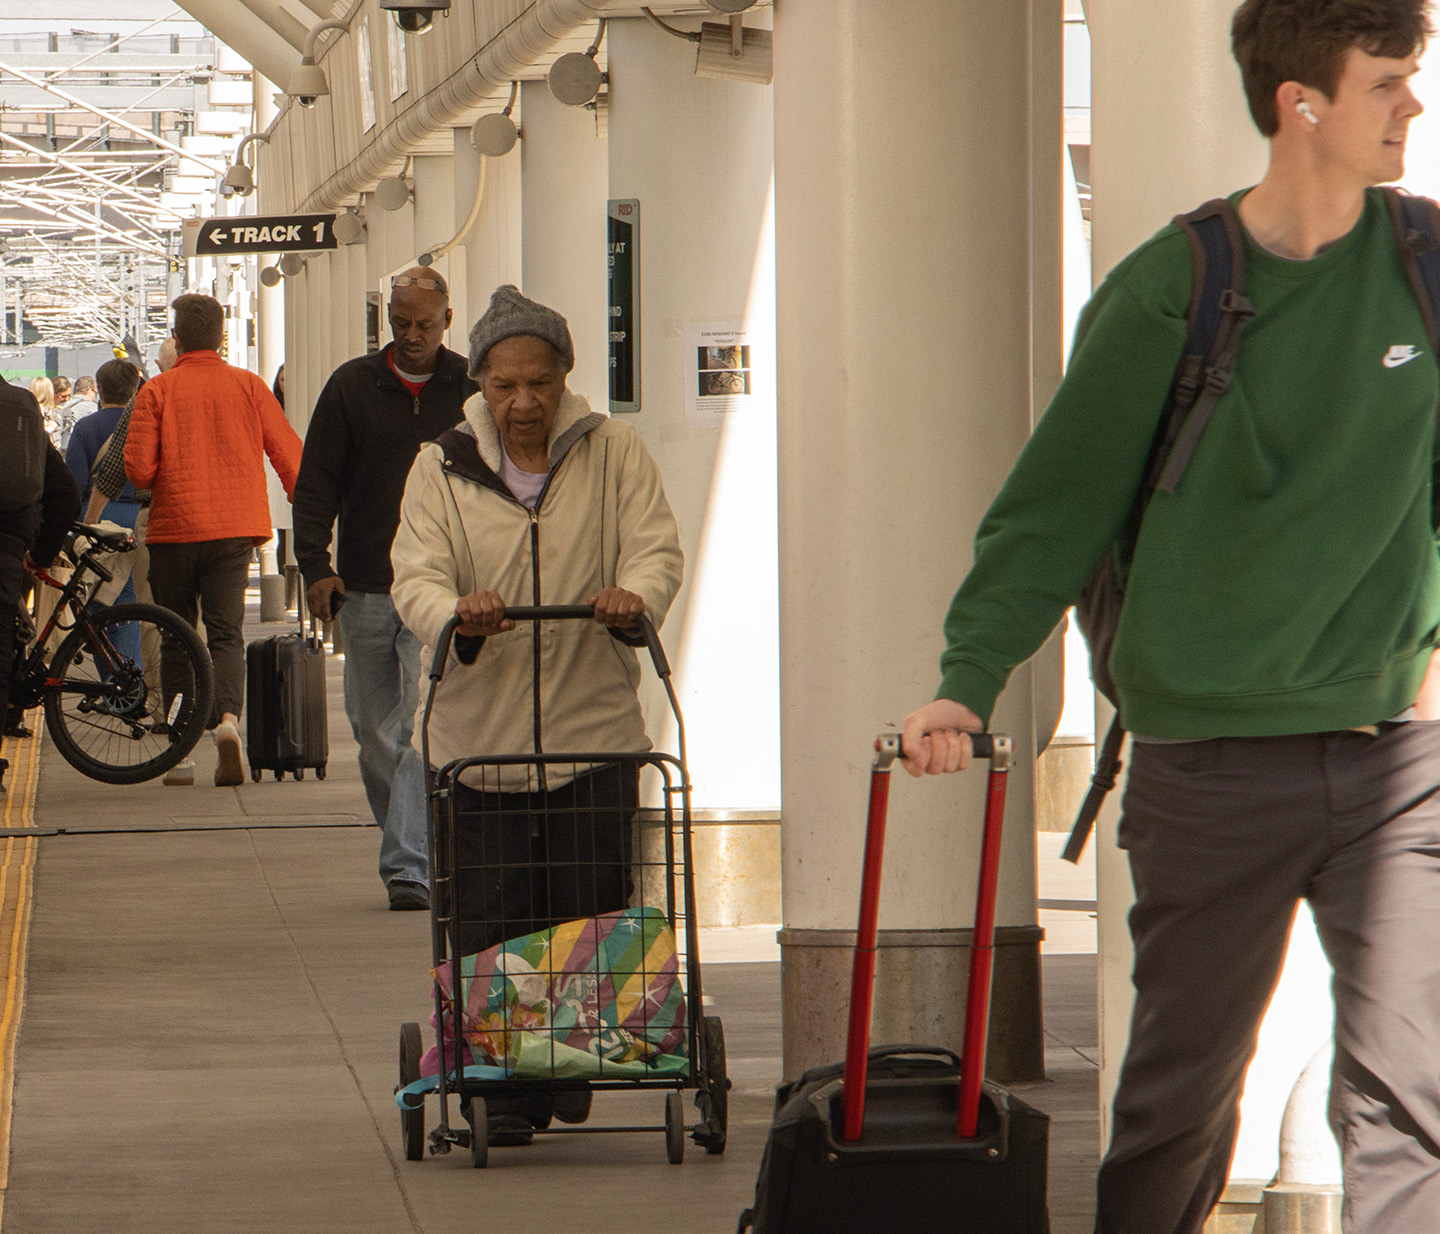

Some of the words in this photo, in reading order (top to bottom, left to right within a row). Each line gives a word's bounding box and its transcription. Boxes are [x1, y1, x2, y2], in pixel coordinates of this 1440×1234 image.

[618, 203, 634, 216] RTD
[231, 225, 302, 244] TRACK
[312, 221, 326, 243] 1
